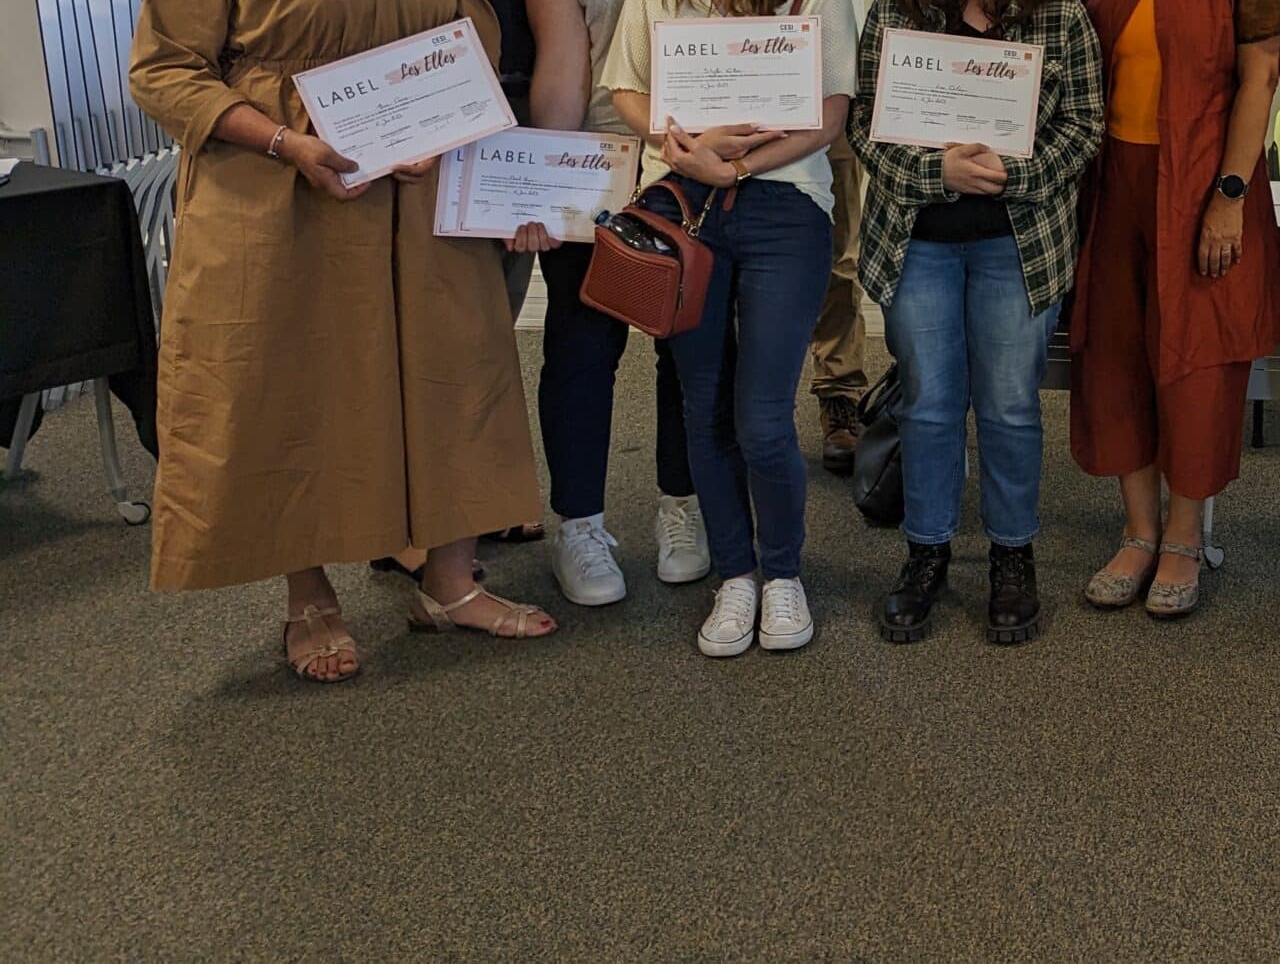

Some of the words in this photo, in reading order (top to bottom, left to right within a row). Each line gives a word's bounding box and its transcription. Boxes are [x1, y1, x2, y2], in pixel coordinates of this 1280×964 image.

[663, 43, 719, 57] LABEL
[740, 38, 761, 54] Les
[763, 36, 797, 55] Elles
[316, 78, 380, 109] LABEL
[400, 62, 421, 80] Les
[424, 48, 456, 72] Elles
[892, 53, 944, 72] LABEL
[964, 59, 984, 76] Les
[986, 62, 1017, 80] Elles
[480, 147, 536, 165] LABEL
[557, 152, 578, 168] Les
[580, 153, 613, 171] Elles
